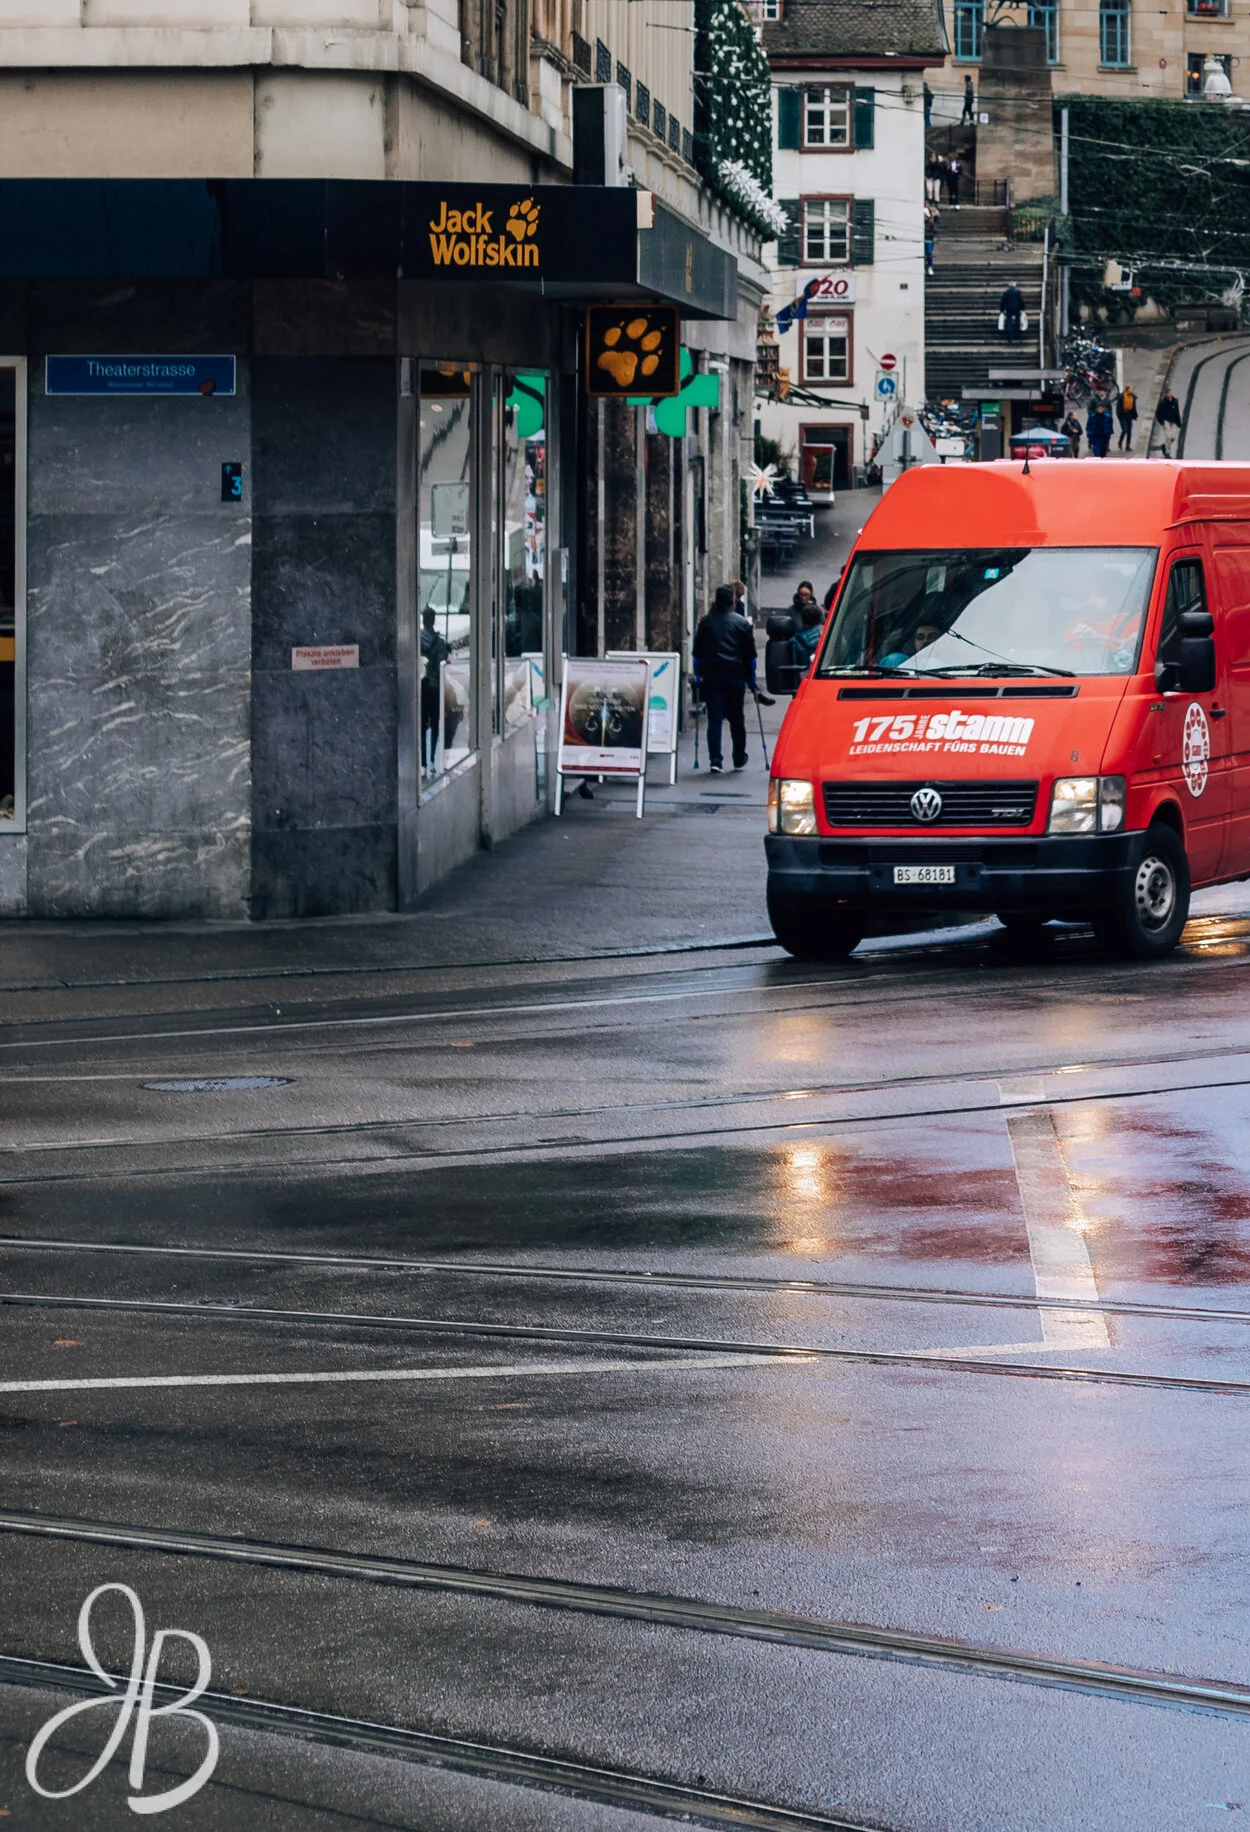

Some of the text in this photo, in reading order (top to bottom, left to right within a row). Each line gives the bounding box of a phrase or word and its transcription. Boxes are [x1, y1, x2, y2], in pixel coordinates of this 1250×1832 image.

[429, 201, 494, 233] Jack
[429, 234, 539, 267] Wolfskin
[87, 360, 196, 377] Theaterstrasse
[231, 476, 242, 496] 3
[295, 648, 355, 658] Plakate ankleben
[311, 658, 341, 666] verboten
[853, 714, 917, 743] 175
[925, 710, 1036, 744] stamm
[849, 741, 1027, 757] LEIDENSCHAFT FÜRS BAUEN
